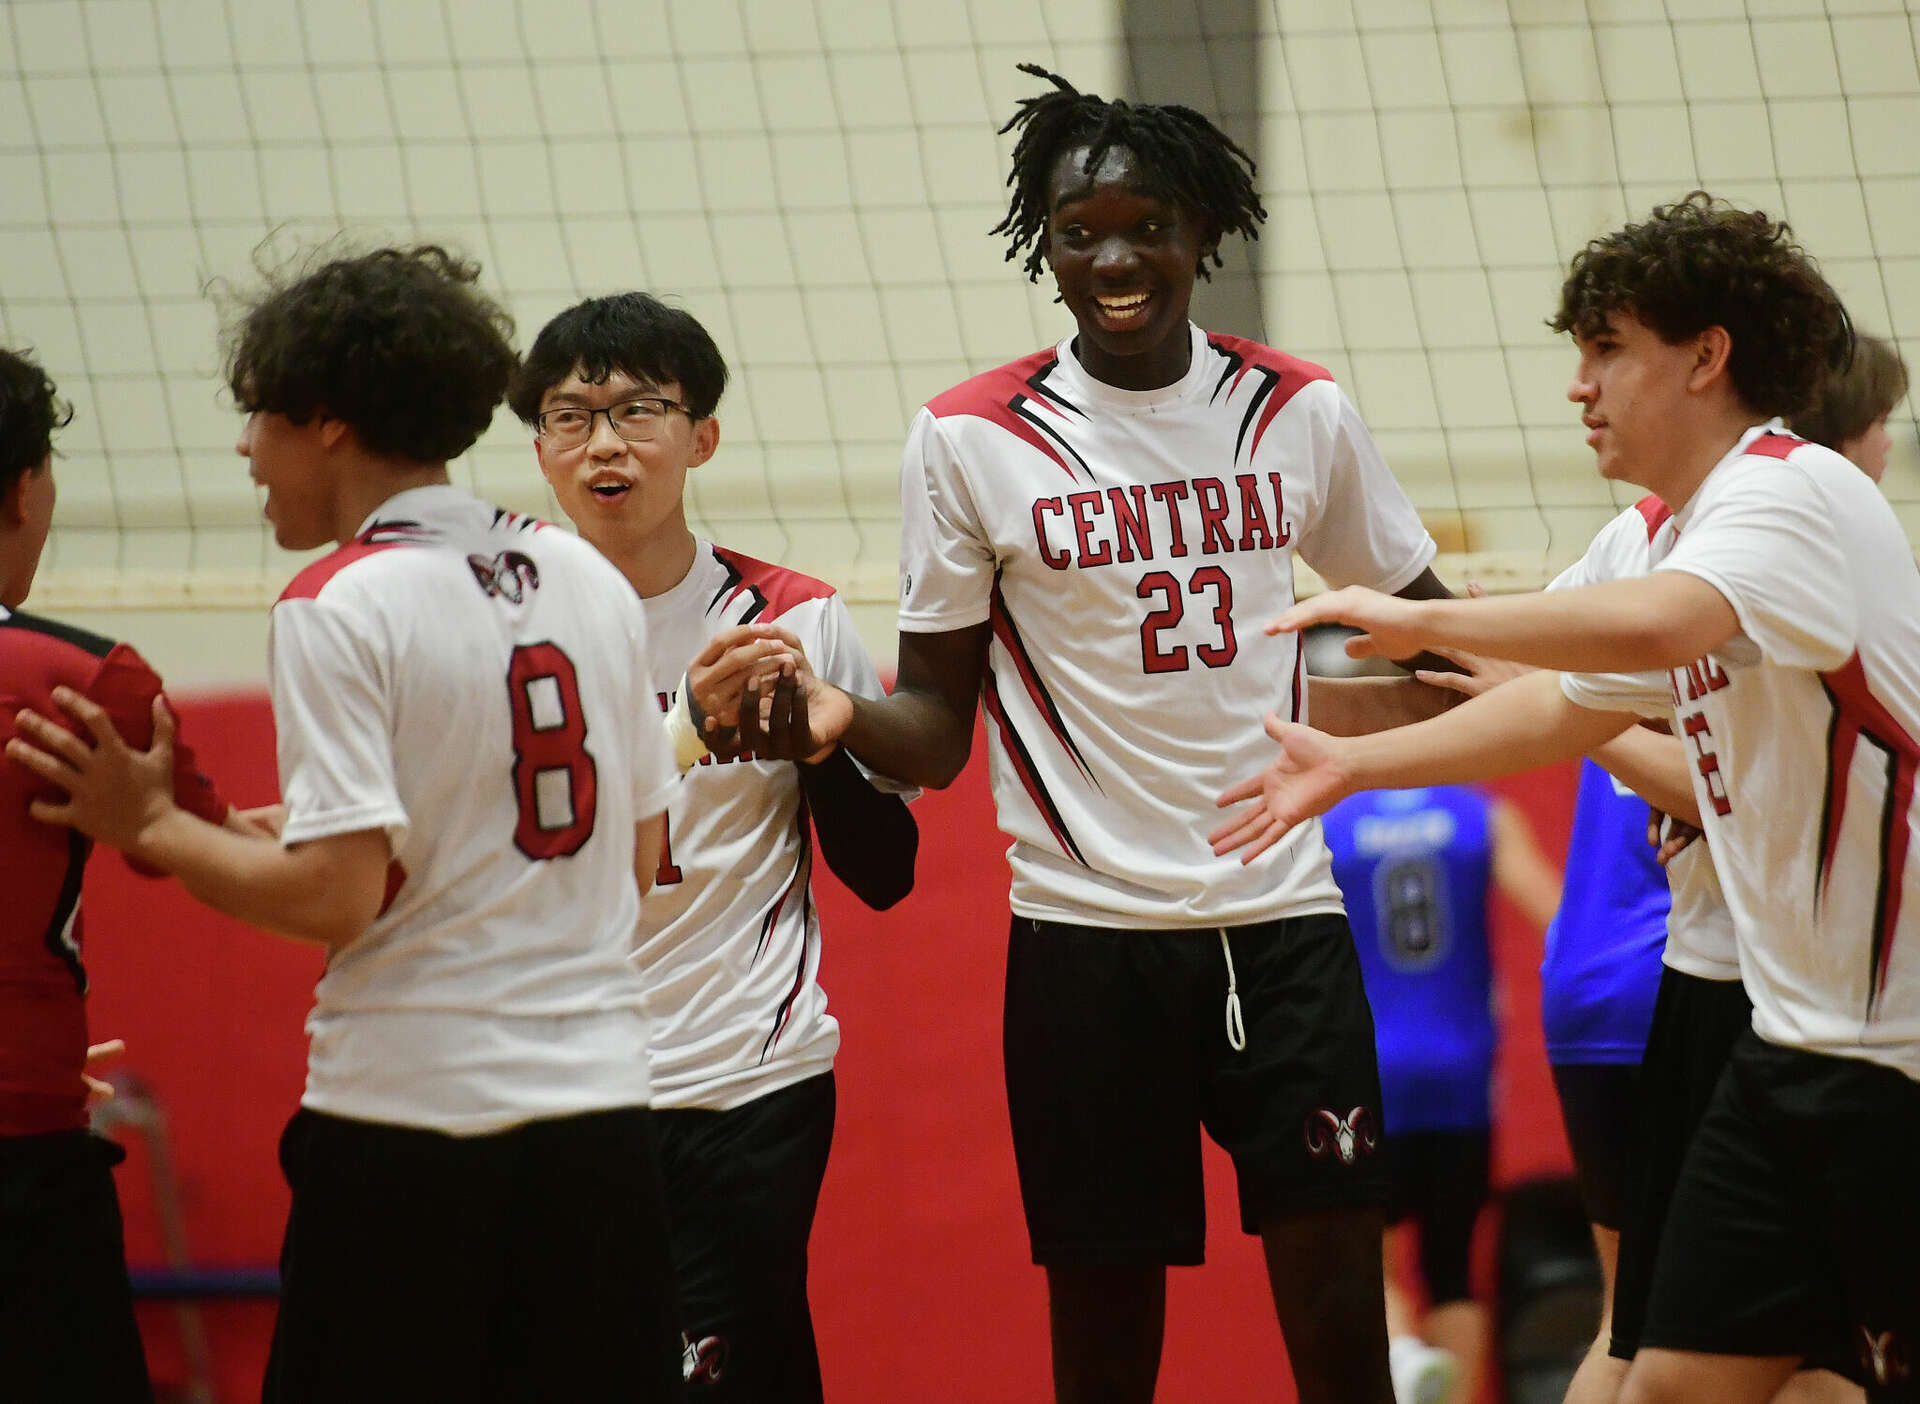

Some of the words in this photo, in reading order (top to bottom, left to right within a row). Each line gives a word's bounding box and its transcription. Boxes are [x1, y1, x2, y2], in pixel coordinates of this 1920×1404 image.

[1032, 472, 1291, 570] CENTRAL
[1136, 565, 1238, 674] 23
[507, 641, 597, 861] 8
